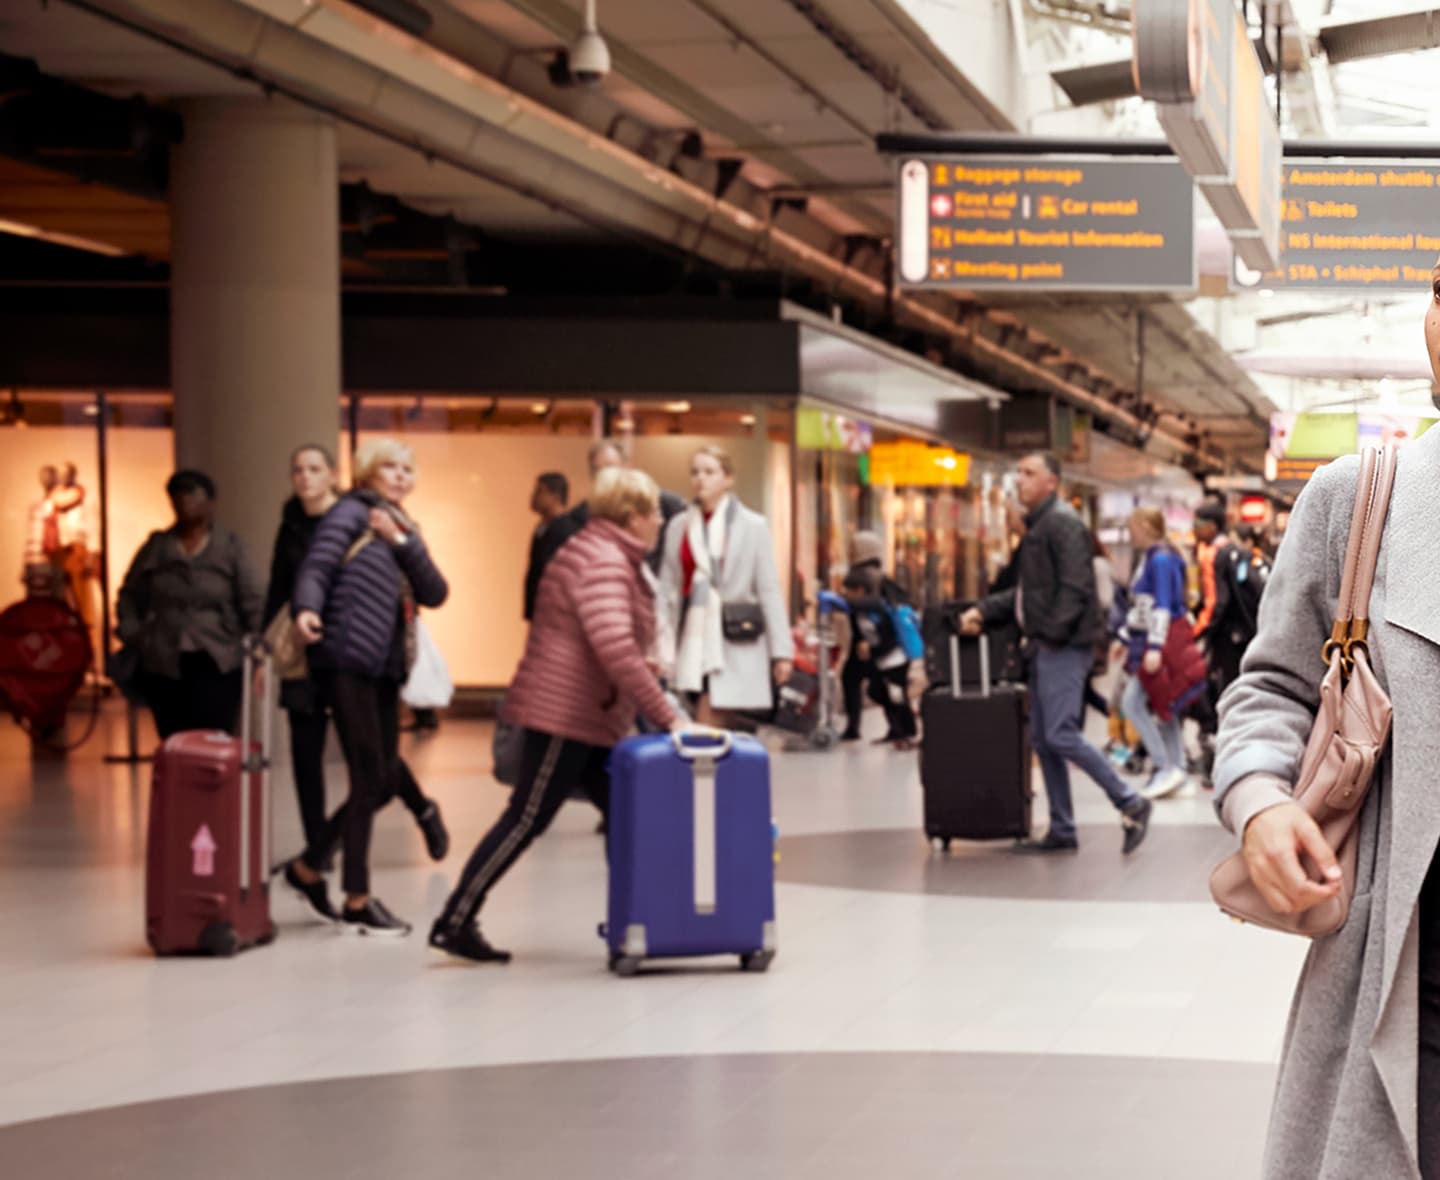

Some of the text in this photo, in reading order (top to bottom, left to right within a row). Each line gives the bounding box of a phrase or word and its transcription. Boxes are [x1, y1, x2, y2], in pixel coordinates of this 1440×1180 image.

[954, 166, 1083, 185] Baggage storage
[1290, 171, 1377, 185] Amsterdam
[1380, 171, 1434, 186] shuttle
[954, 191, 1017, 207] First aid
[1062, 199, 1138, 215] Car rental
[1308, 201, 1358, 218] Toilets
[954, 229, 1164, 247] Holland Tourist Information
[1289, 234, 1311, 248] NS
[1313, 234, 1413, 249] International
[954, 261, 1063, 280] Meeting point
[1289, 265, 1318, 279] STA
[1335, 265, 1399, 282] Schiphol
